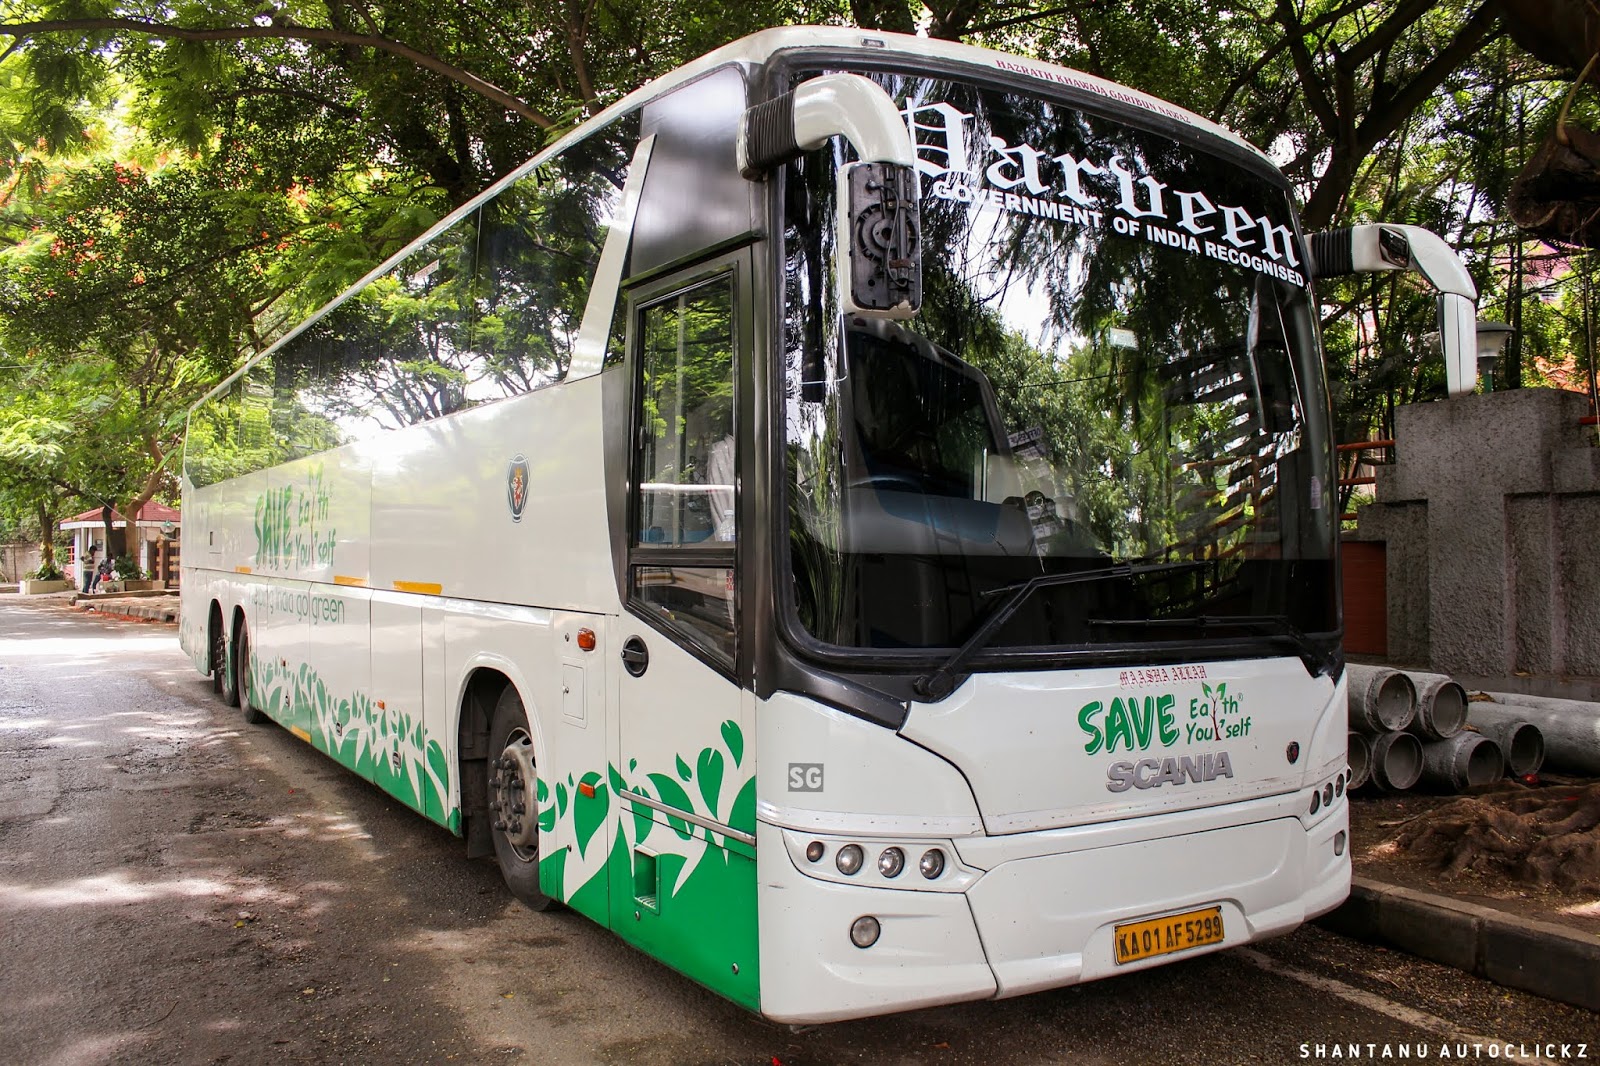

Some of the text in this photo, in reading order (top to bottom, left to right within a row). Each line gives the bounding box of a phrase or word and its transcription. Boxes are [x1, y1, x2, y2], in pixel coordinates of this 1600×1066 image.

[995, 59, 1192, 124] HAZRATH KHAWAJA GARIBUN NAWAZ
[932, 179, 1305, 288] GOVERNMENT OF INDIA RECOGNISED
[254, 483, 293, 572] SAVE
[296, 594, 310, 622] go
[311, 597, 346, 625] green
[1171, 664, 1208, 682] ALLAH
[1078, 693, 1181, 756] SAVE
[789, 766, 822, 789] SG
[1106, 751, 1234, 794] SCANIA
